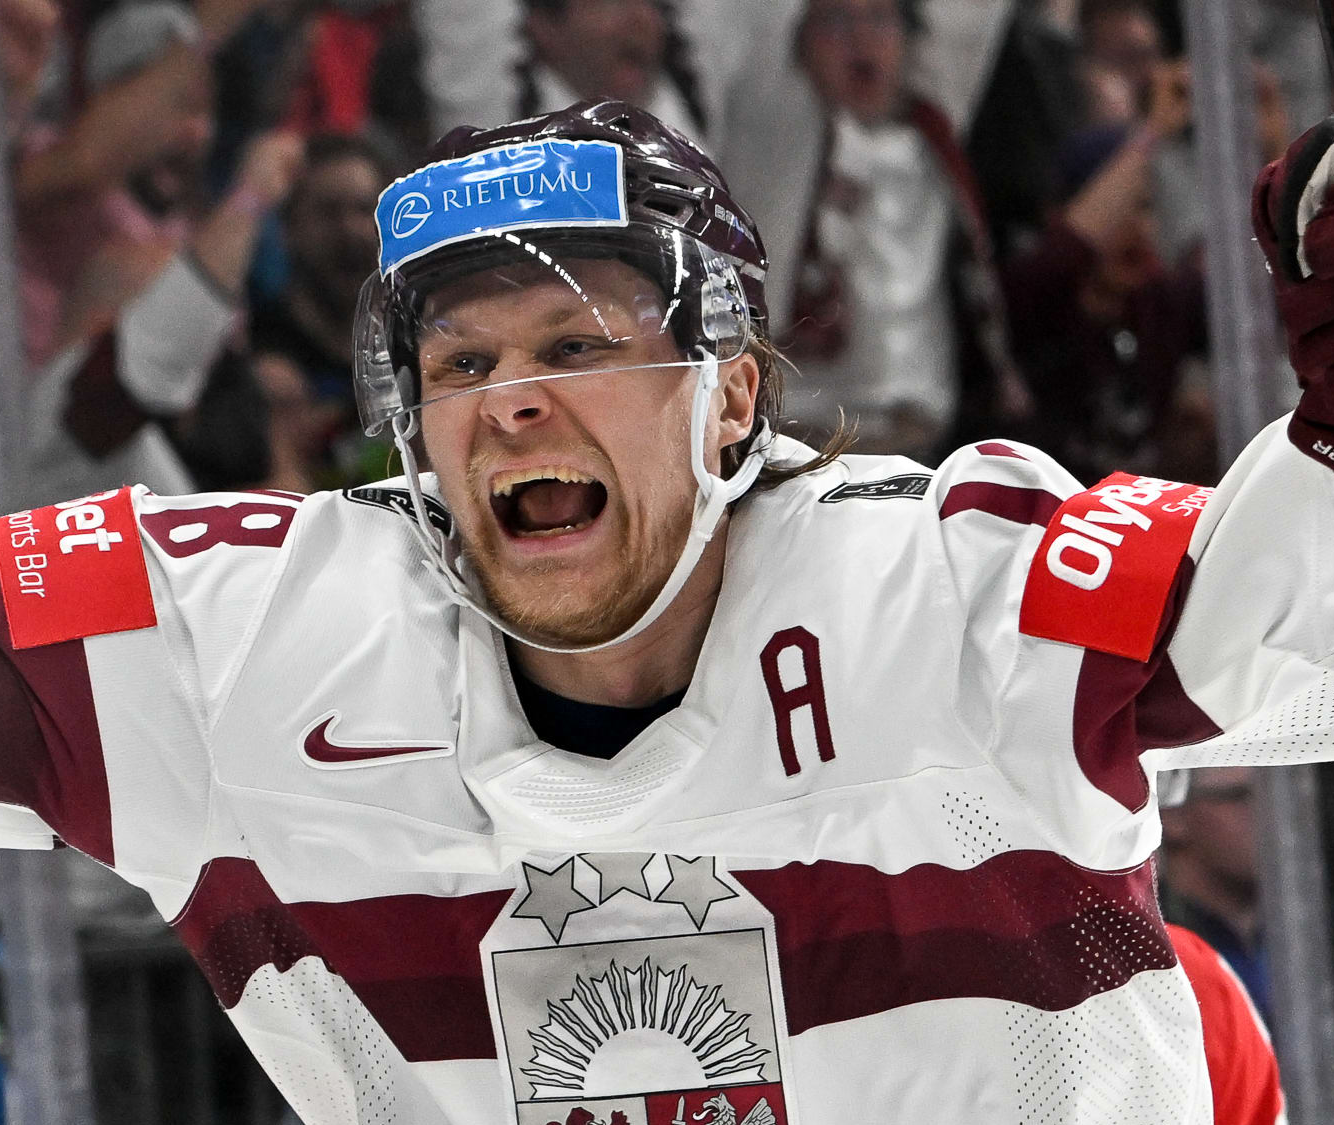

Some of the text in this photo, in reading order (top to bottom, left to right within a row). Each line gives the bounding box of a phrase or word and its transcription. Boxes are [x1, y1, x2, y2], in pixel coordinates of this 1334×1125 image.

[443, 171, 592, 212] RIETUMU
[14, 553, 48, 598] Bar
[759, 625, 837, 777] A
